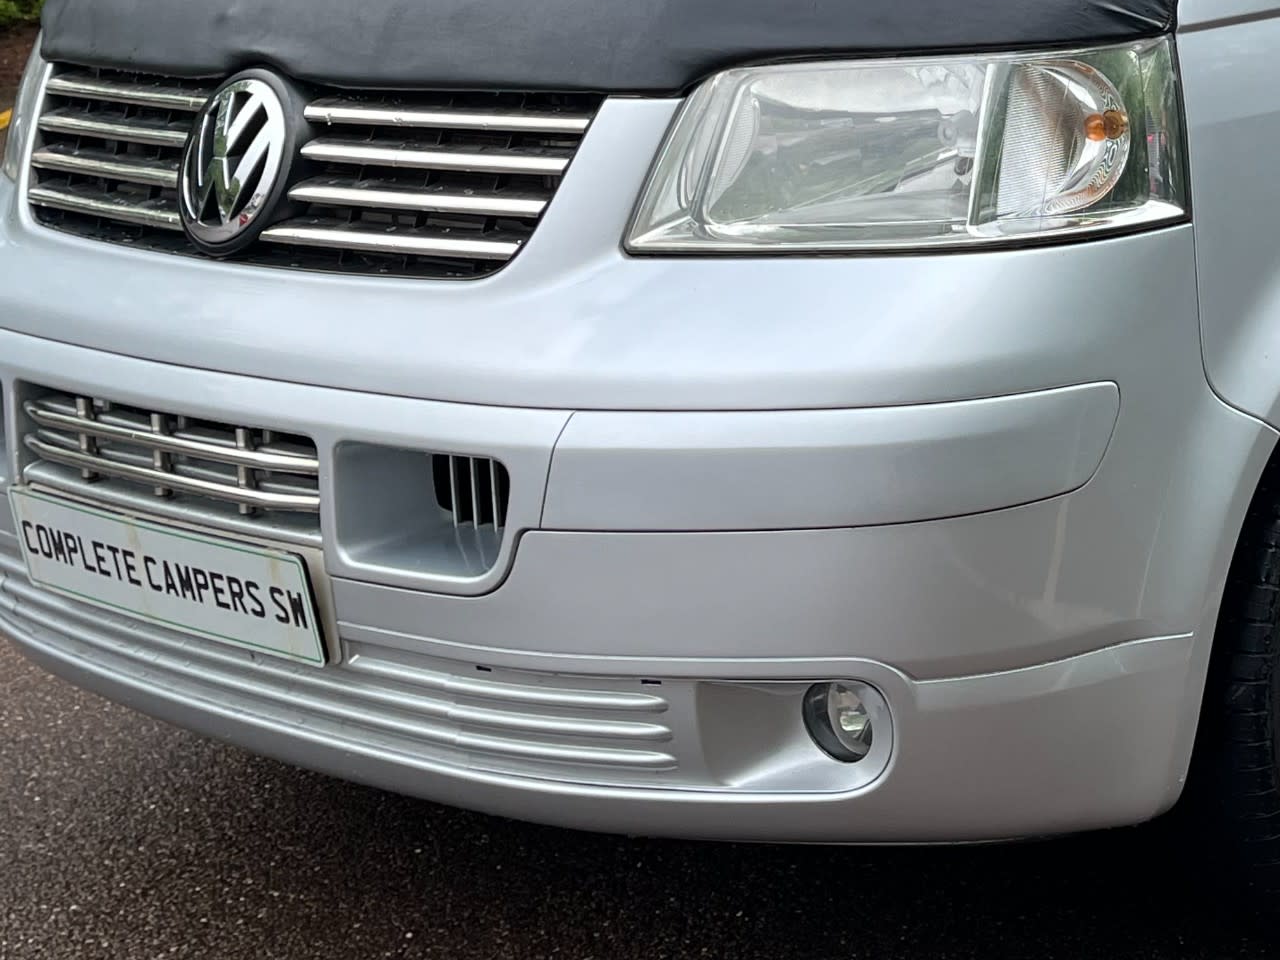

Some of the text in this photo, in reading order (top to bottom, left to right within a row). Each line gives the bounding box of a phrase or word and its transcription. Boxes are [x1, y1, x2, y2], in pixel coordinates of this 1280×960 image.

[21, 519, 309, 630] COMPLETE CAMPERS SW
